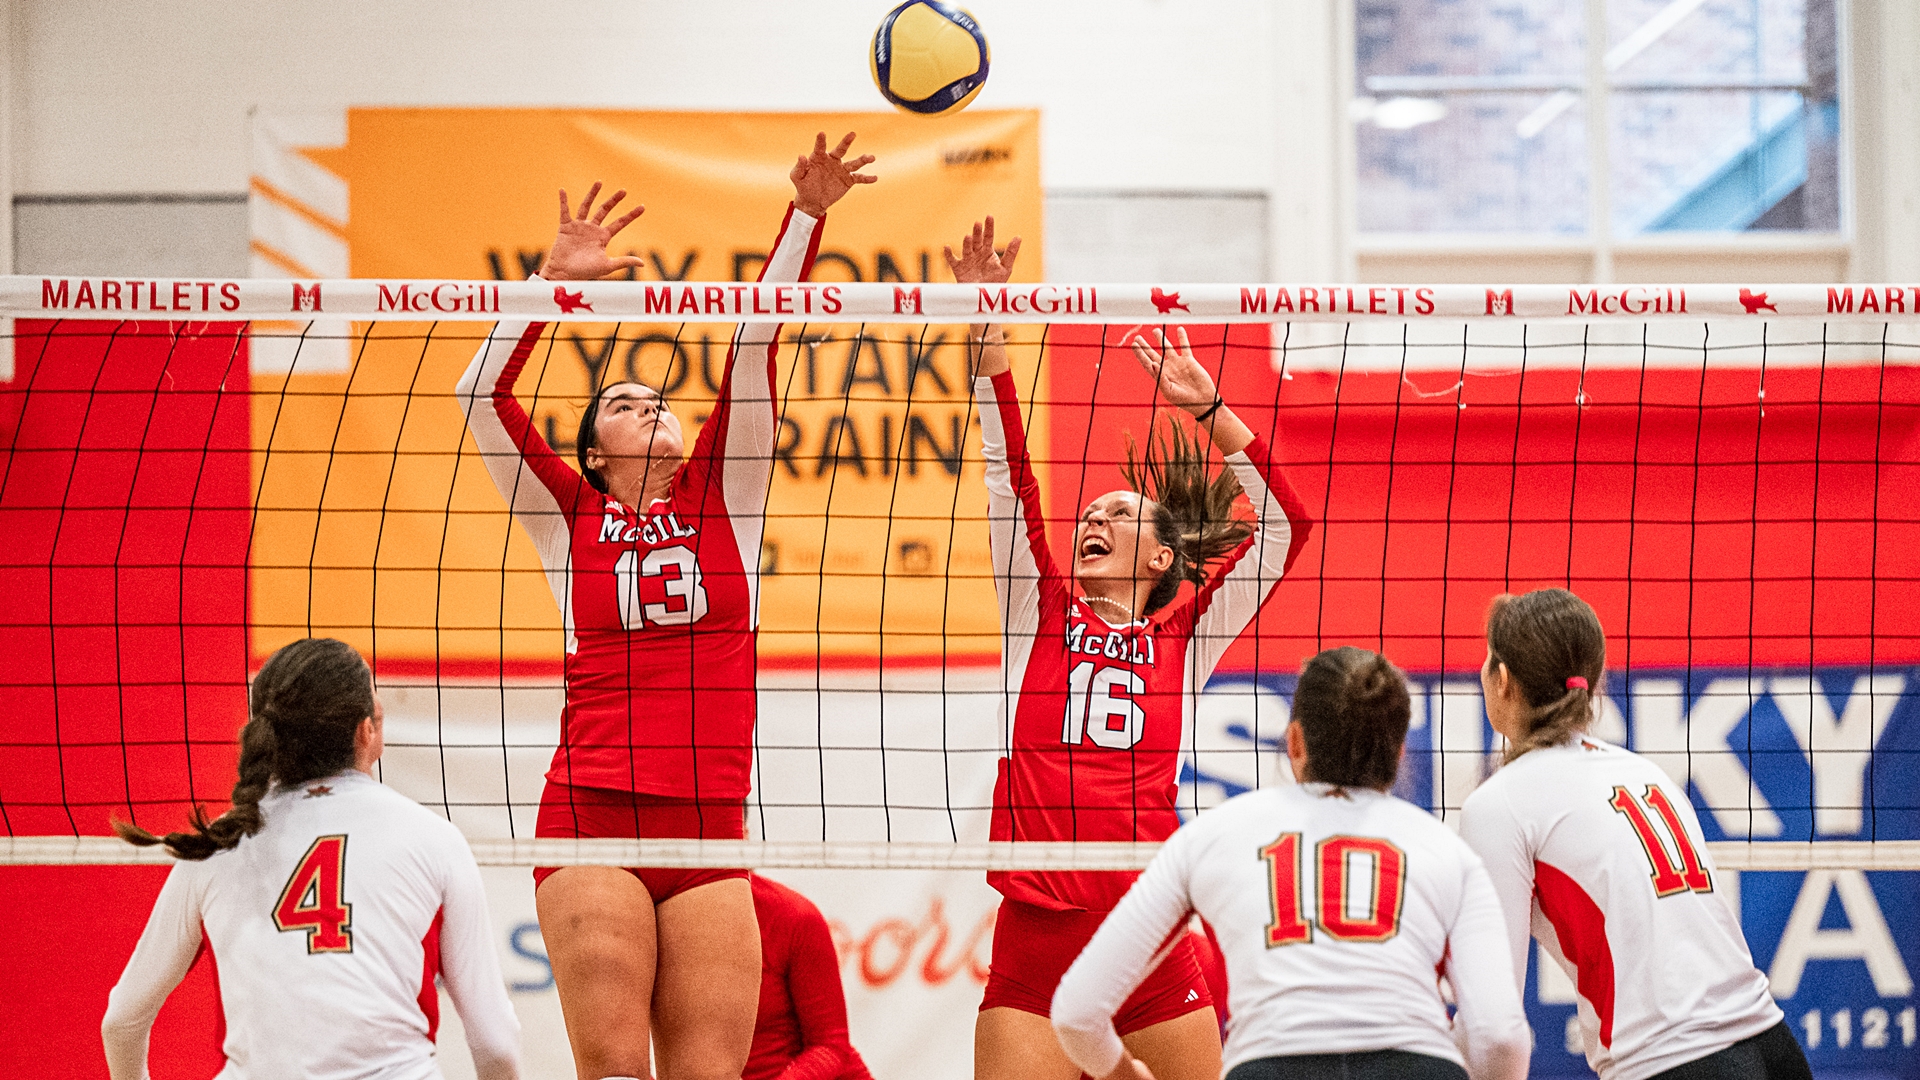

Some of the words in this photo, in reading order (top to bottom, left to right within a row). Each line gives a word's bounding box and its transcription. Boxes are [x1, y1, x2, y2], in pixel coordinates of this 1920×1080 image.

[41, 280, 241, 312] MARTLETS
[377, 284, 501, 313] McGill
[644, 286, 843, 315] MARTLETS
[976, 286, 1099, 315] McGill
[1240, 287, 1435, 316] MARTLETS
[1567, 288, 1688, 316] McGill
[788, 331, 1012, 396] TAK
[613, 544, 710, 631] 13
[1061, 661, 1146, 750] 16
[1609, 783, 1713, 899] 11
[271, 834, 353, 955] 4
[1259, 831, 1407, 949] 10
[1801, 1006, 1918, 1049] 1121
